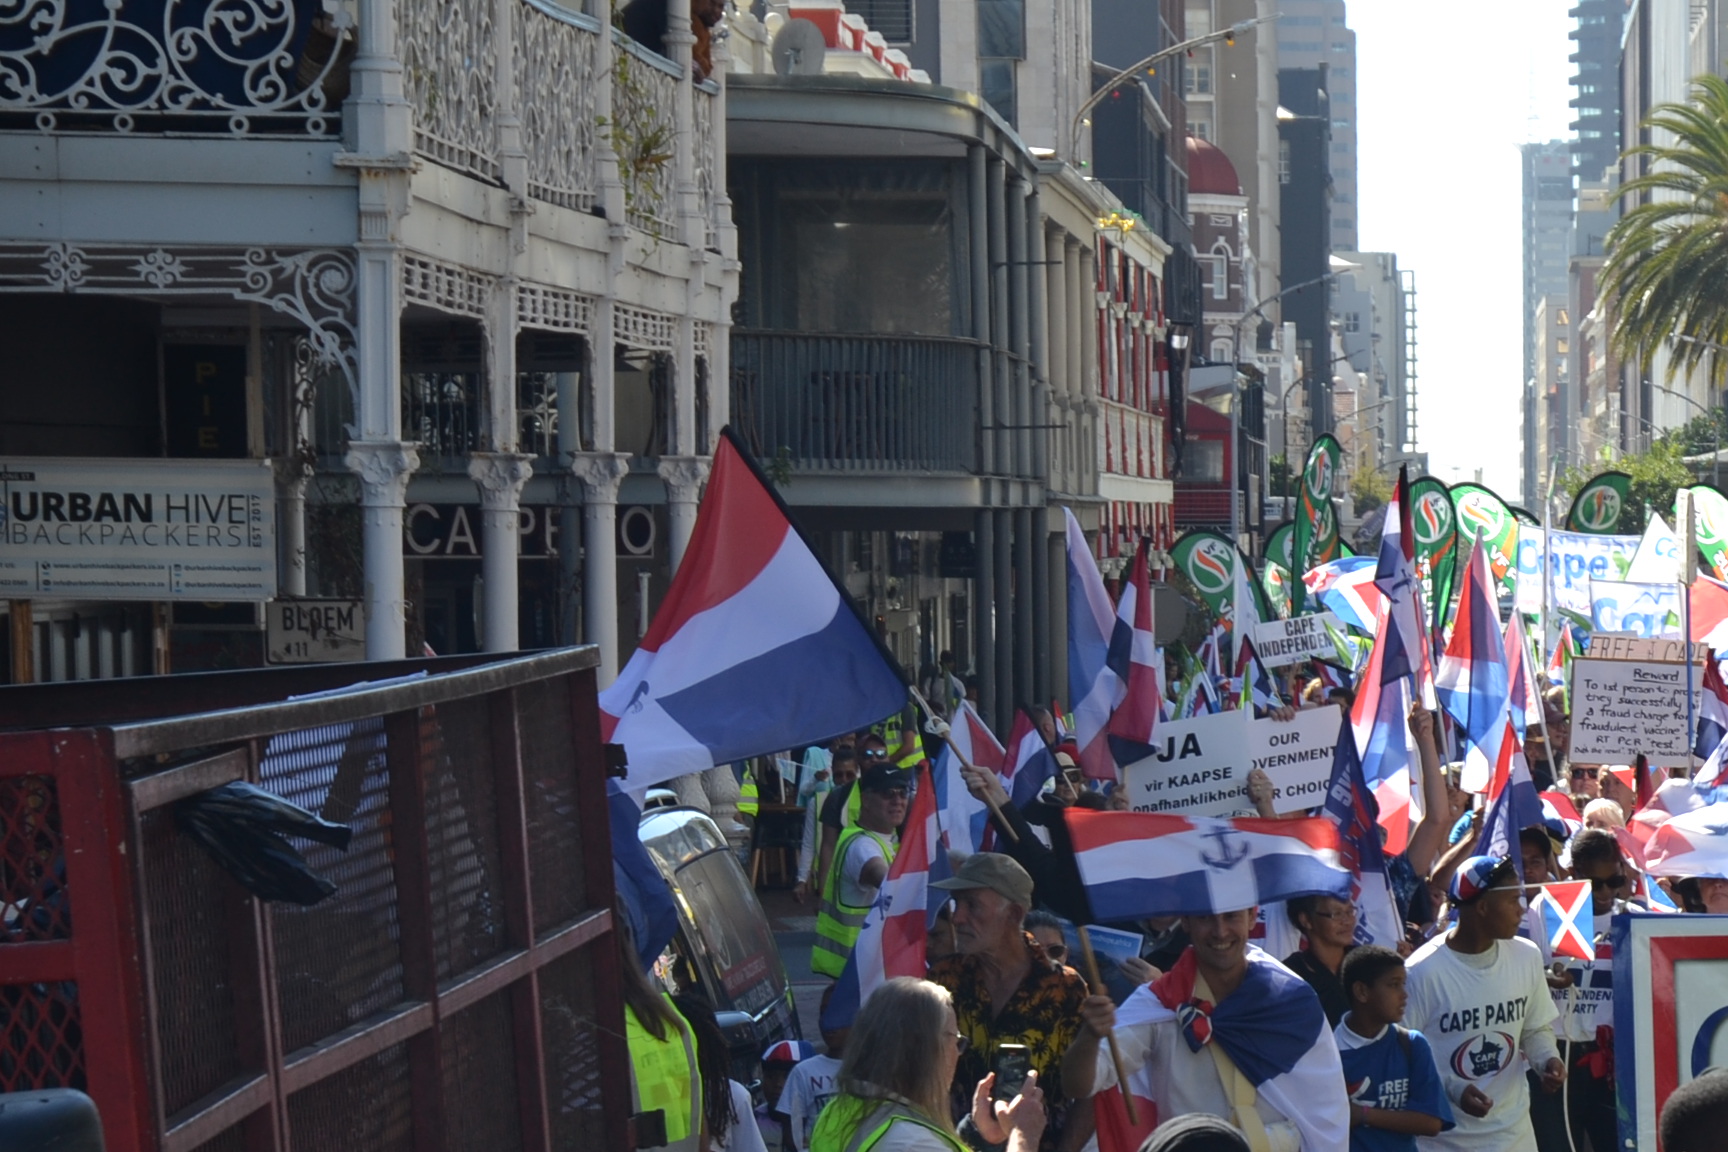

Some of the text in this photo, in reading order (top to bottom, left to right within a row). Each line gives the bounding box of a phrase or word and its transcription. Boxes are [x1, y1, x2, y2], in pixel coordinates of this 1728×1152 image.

[12, 491, 246, 525] URBAN HIVE
[252, 494, 262, 548] EST 2017
[12, 523, 242, 547] BACKPACKERS
[282, 607, 354, 633] BLOEM
[1285, 617, 1316, 637] CAPE
[1259, 630, 1338, 659] INDEPENDEN
[1589, 635, 1640, 660] FREE
[1633, 668, 1680, 682] Reward
[1584, 679, 1599, 691] To
[1622, 684, 1656, 697] person
[1673, 688, 1701, 698] proe
[1586, 693, 1613, 707] they
[1600, 706, 1631, 718] fraud
[1633, 710, 1671, 726] charge
[1157, 732, 1203, 764] JA
[1269, 731, 1301, 748] OUR
[1252, 745, 1339, 769] VERNMENT
[1145, 766, 1233, 793] vir KAAPSE
[1439, 995, 1529, 1034] CAPE PARTY
[1378, 1078, 1409, 1097] FREE
[1378, 1092, 1409, 1109] THE
